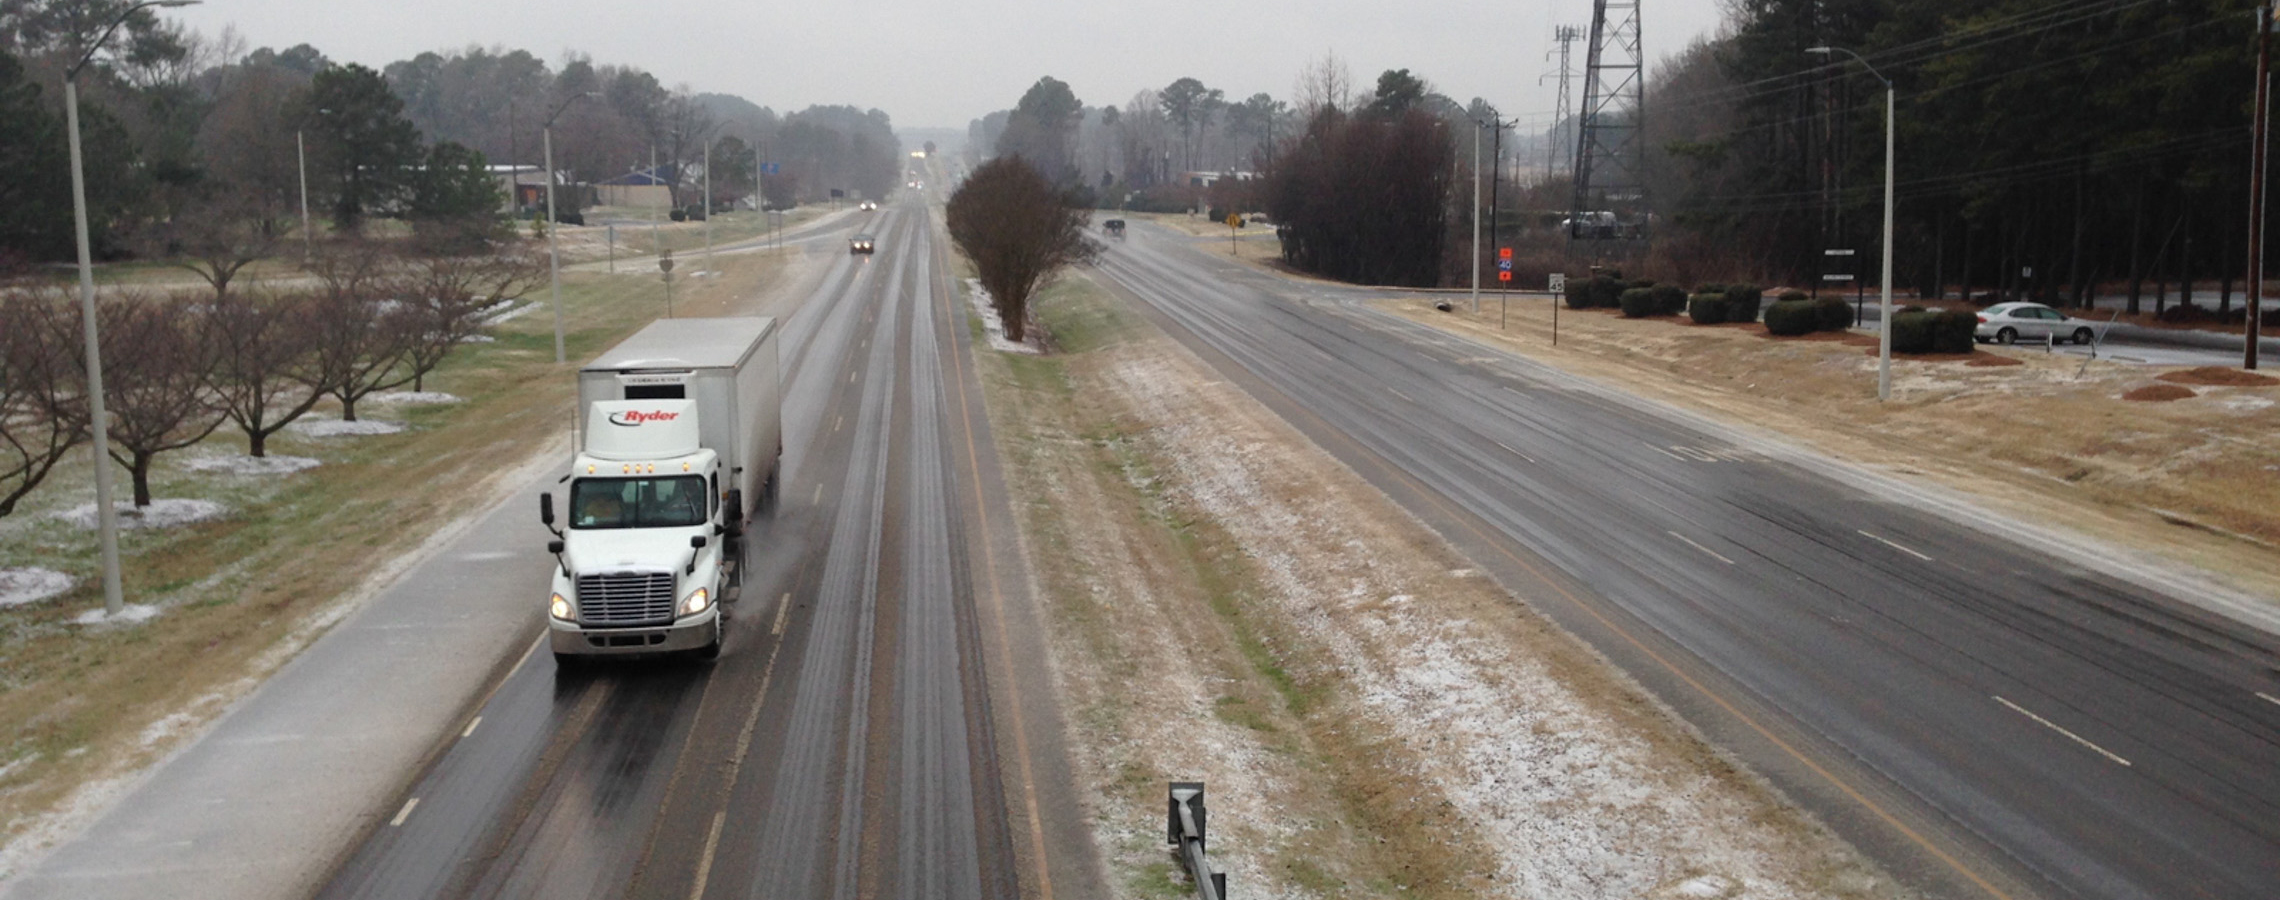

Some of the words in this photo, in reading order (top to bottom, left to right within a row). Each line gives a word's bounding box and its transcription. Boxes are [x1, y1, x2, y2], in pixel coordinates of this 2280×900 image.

[1499, 260, 1511, 269] 40
[1550, 282, 1563, 291] 45
[625, 410, 679, 423] Ryder
